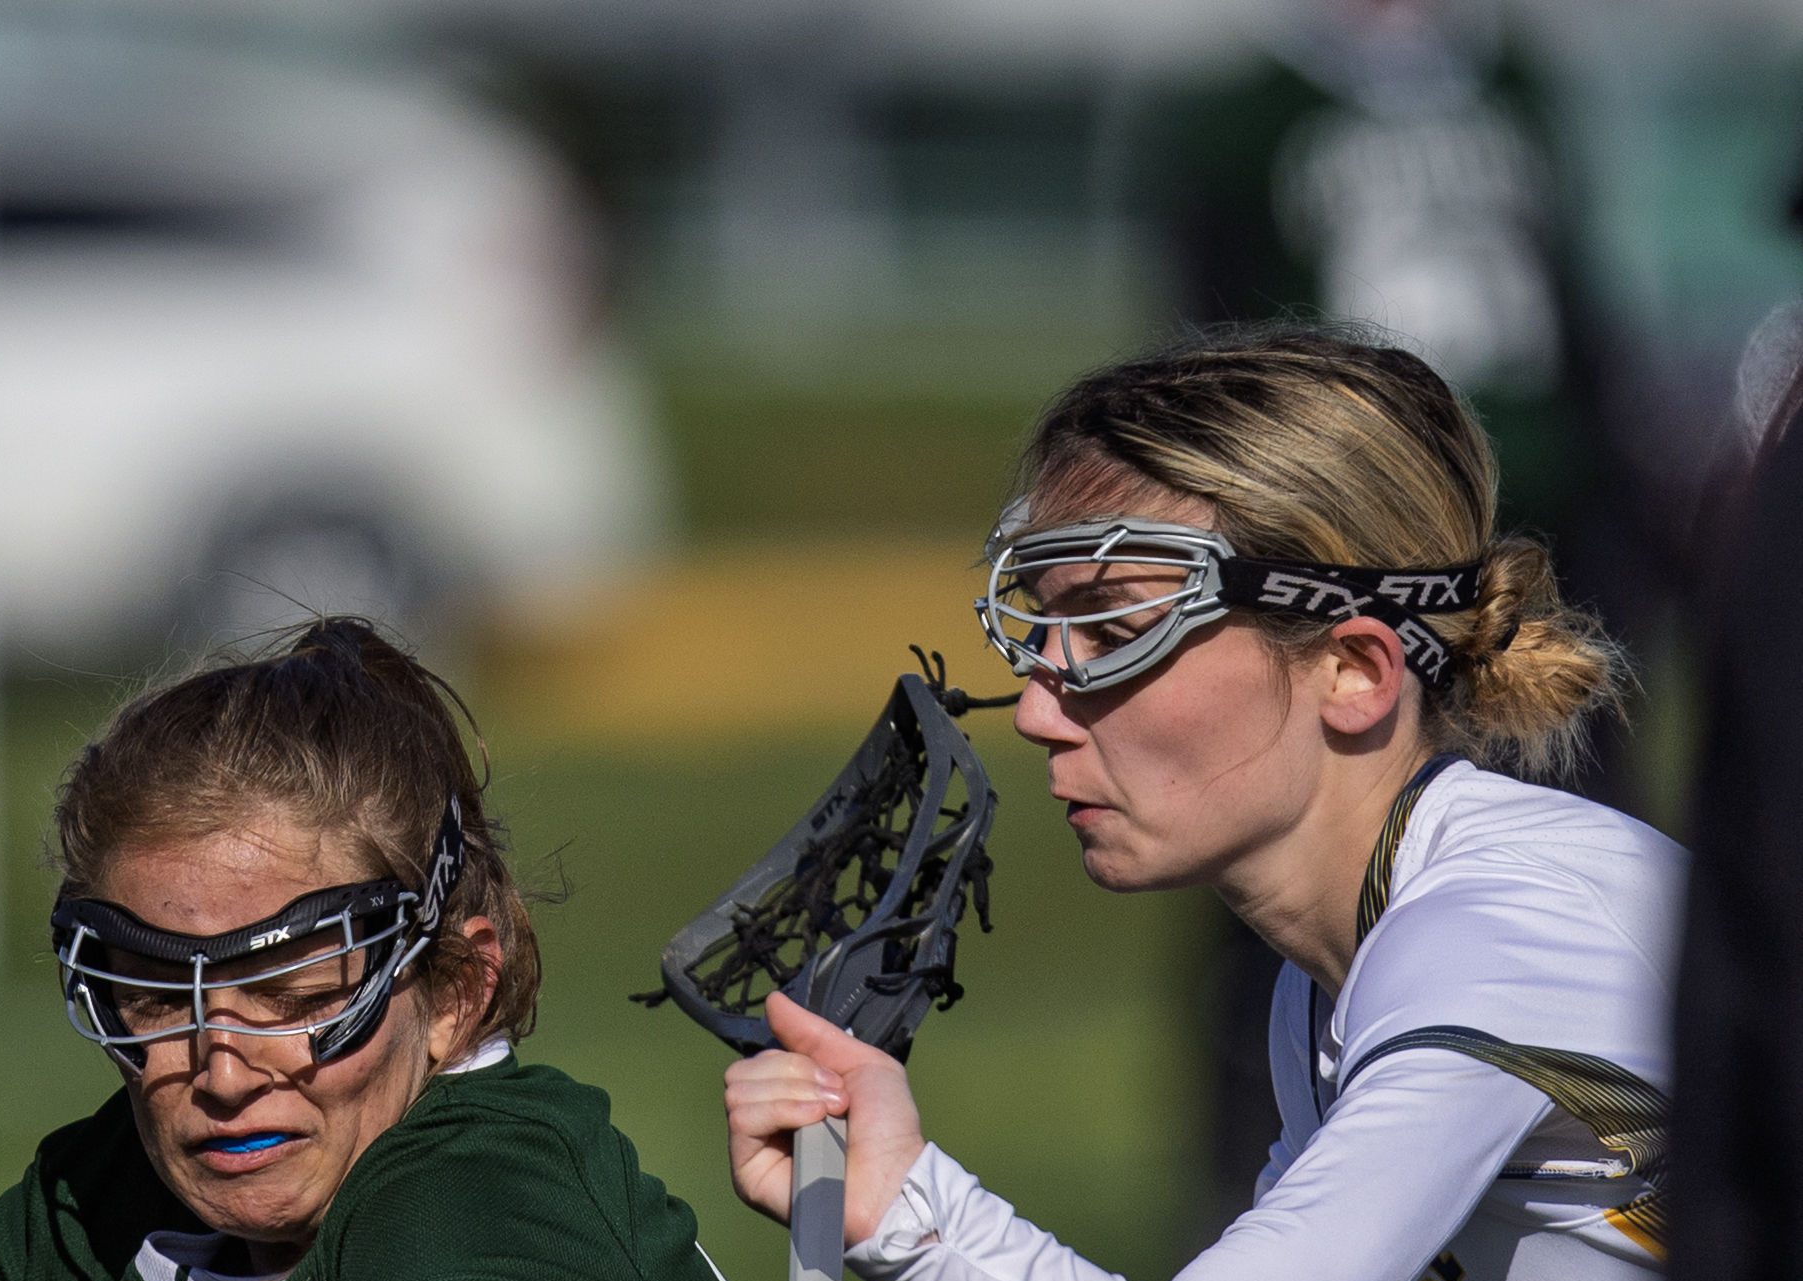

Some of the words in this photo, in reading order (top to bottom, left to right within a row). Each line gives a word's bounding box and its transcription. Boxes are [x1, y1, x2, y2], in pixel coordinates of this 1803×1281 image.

[1258, 571, 1374, 619] STX
[1377, 573, 1464, 606] STX
[1396, 617, 1449, 684] STX
[811, 786, 848, 832] STX
[250, 925, 291, 950] STX
